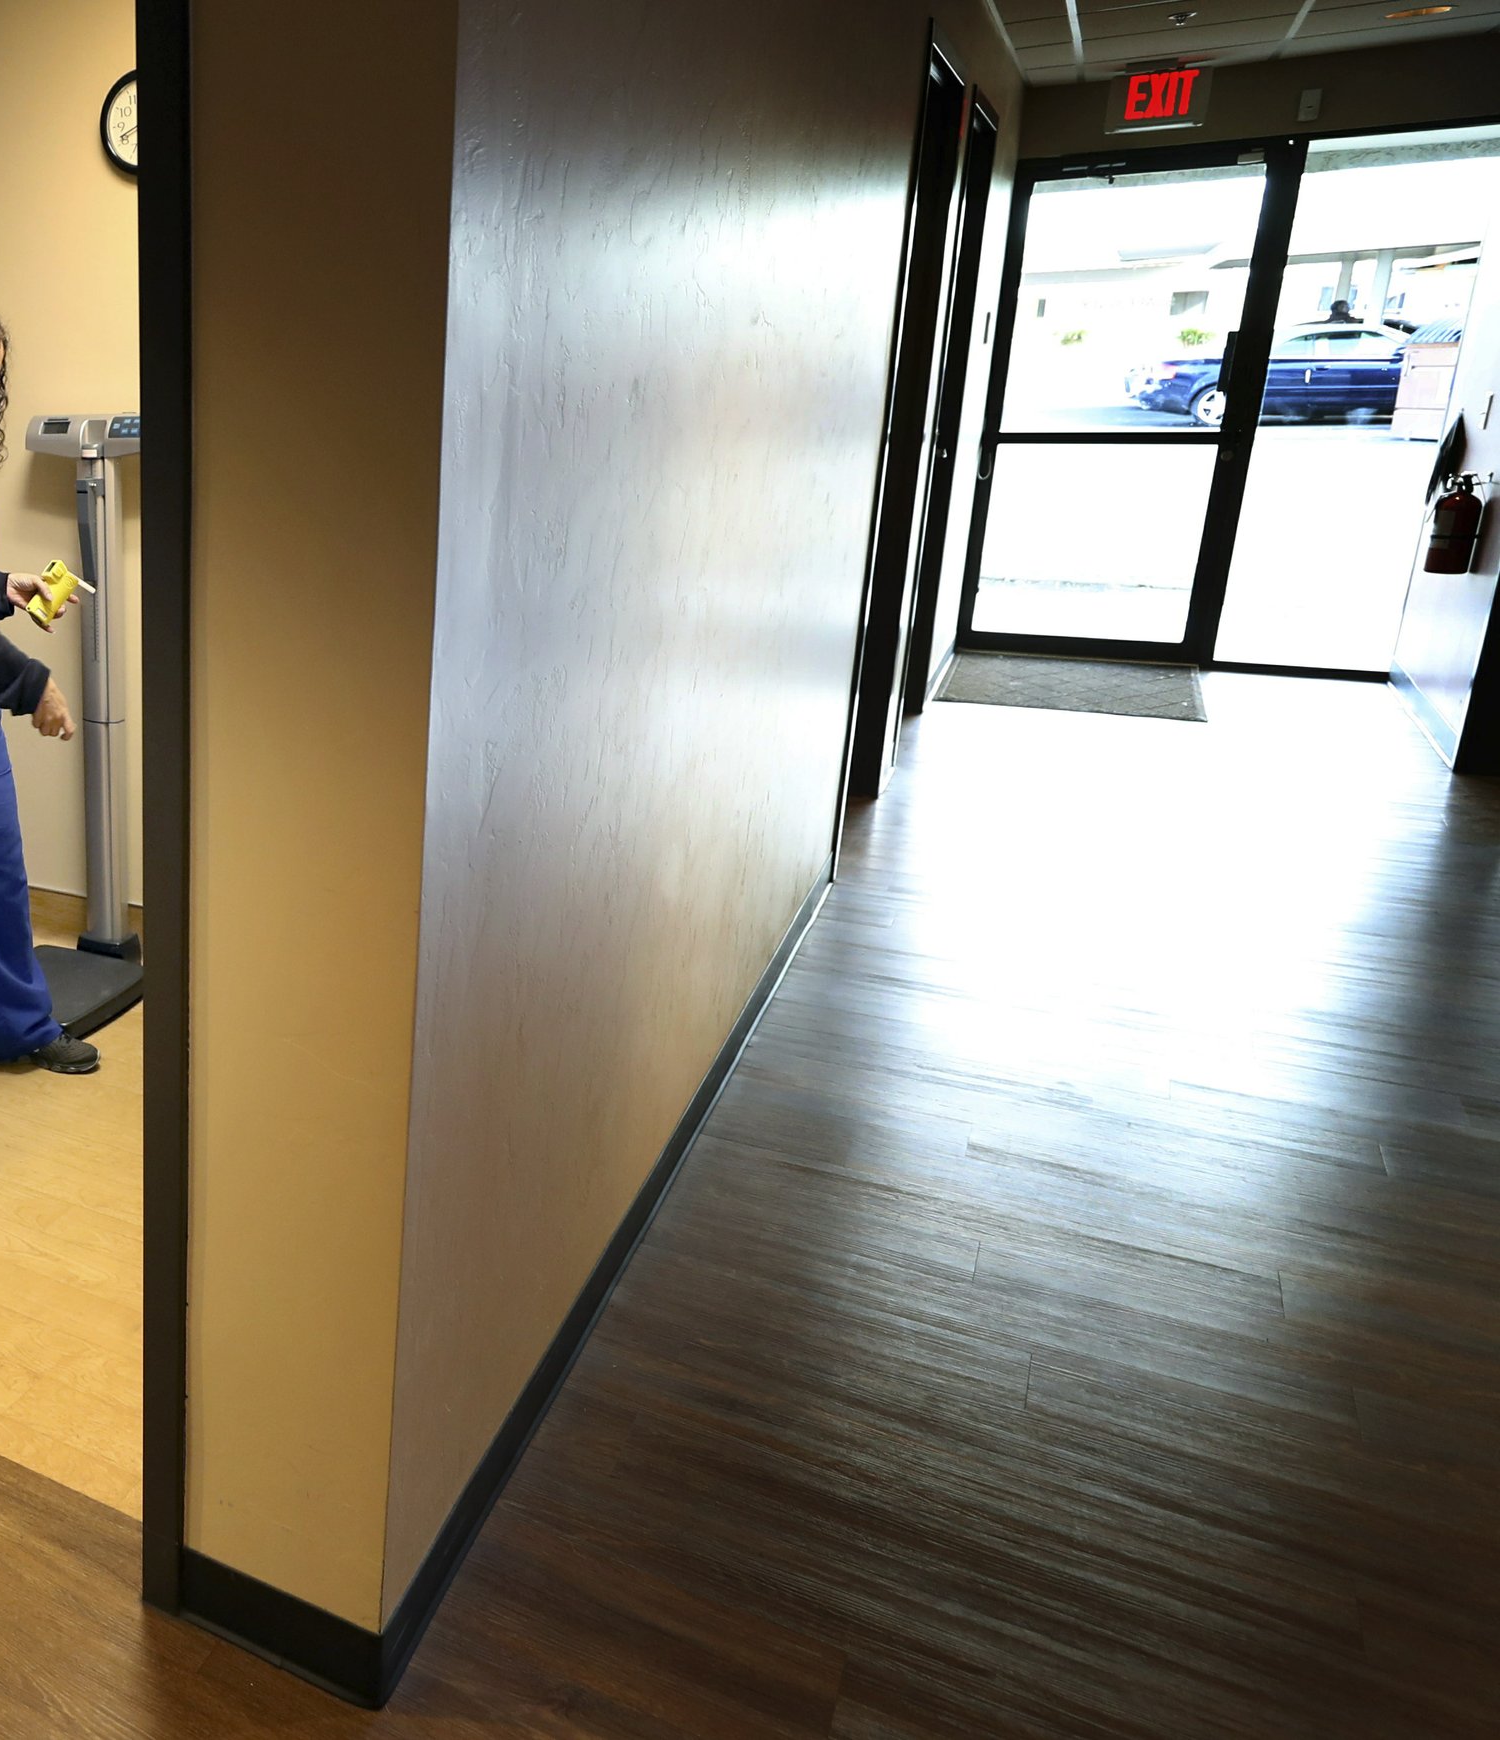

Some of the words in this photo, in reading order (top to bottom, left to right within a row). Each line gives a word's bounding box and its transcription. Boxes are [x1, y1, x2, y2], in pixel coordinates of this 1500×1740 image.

[1124, 69, 1200, 120] EXIT
[120, 106, 132, 118] 10
[117, 122, 125, 132] 9
[121, 134, 129, 145] 8
